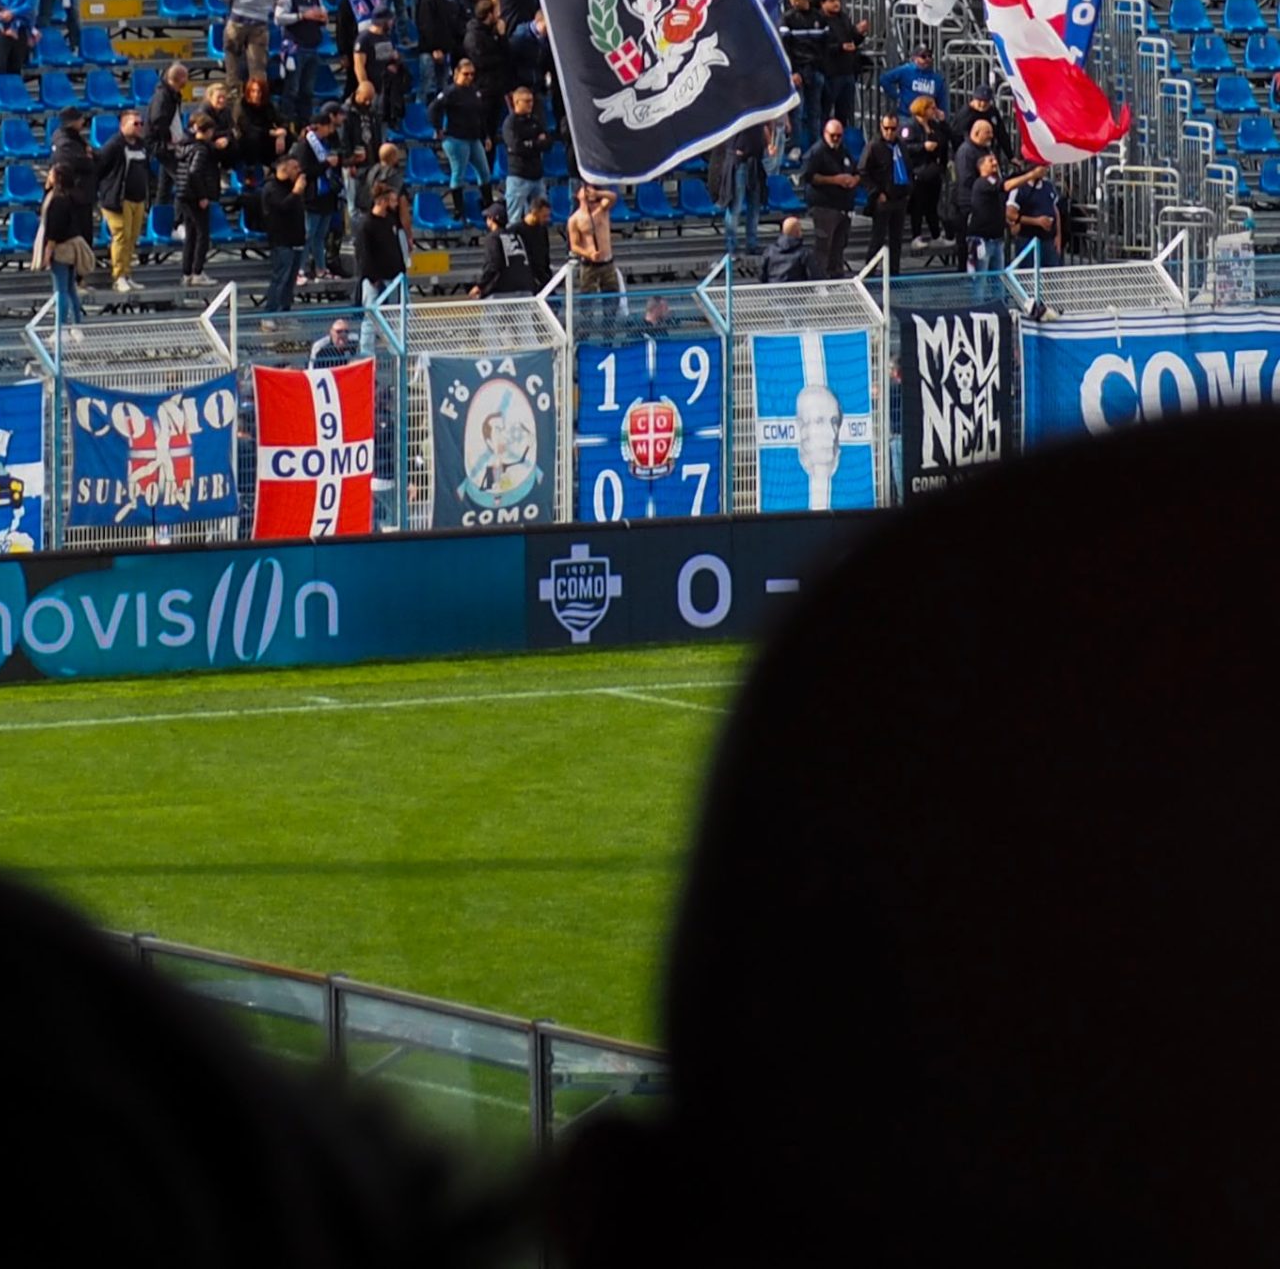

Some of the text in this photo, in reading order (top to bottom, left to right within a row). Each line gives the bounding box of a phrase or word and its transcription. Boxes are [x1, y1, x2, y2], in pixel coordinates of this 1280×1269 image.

[76, 389, 234, 438] COMO
[763, 422, 866, 441] COMO 1907
[271, 444, 370, 478] COMO
[462, 503, 539, 527] COMO
[556, 576, 605, 600] COMO
